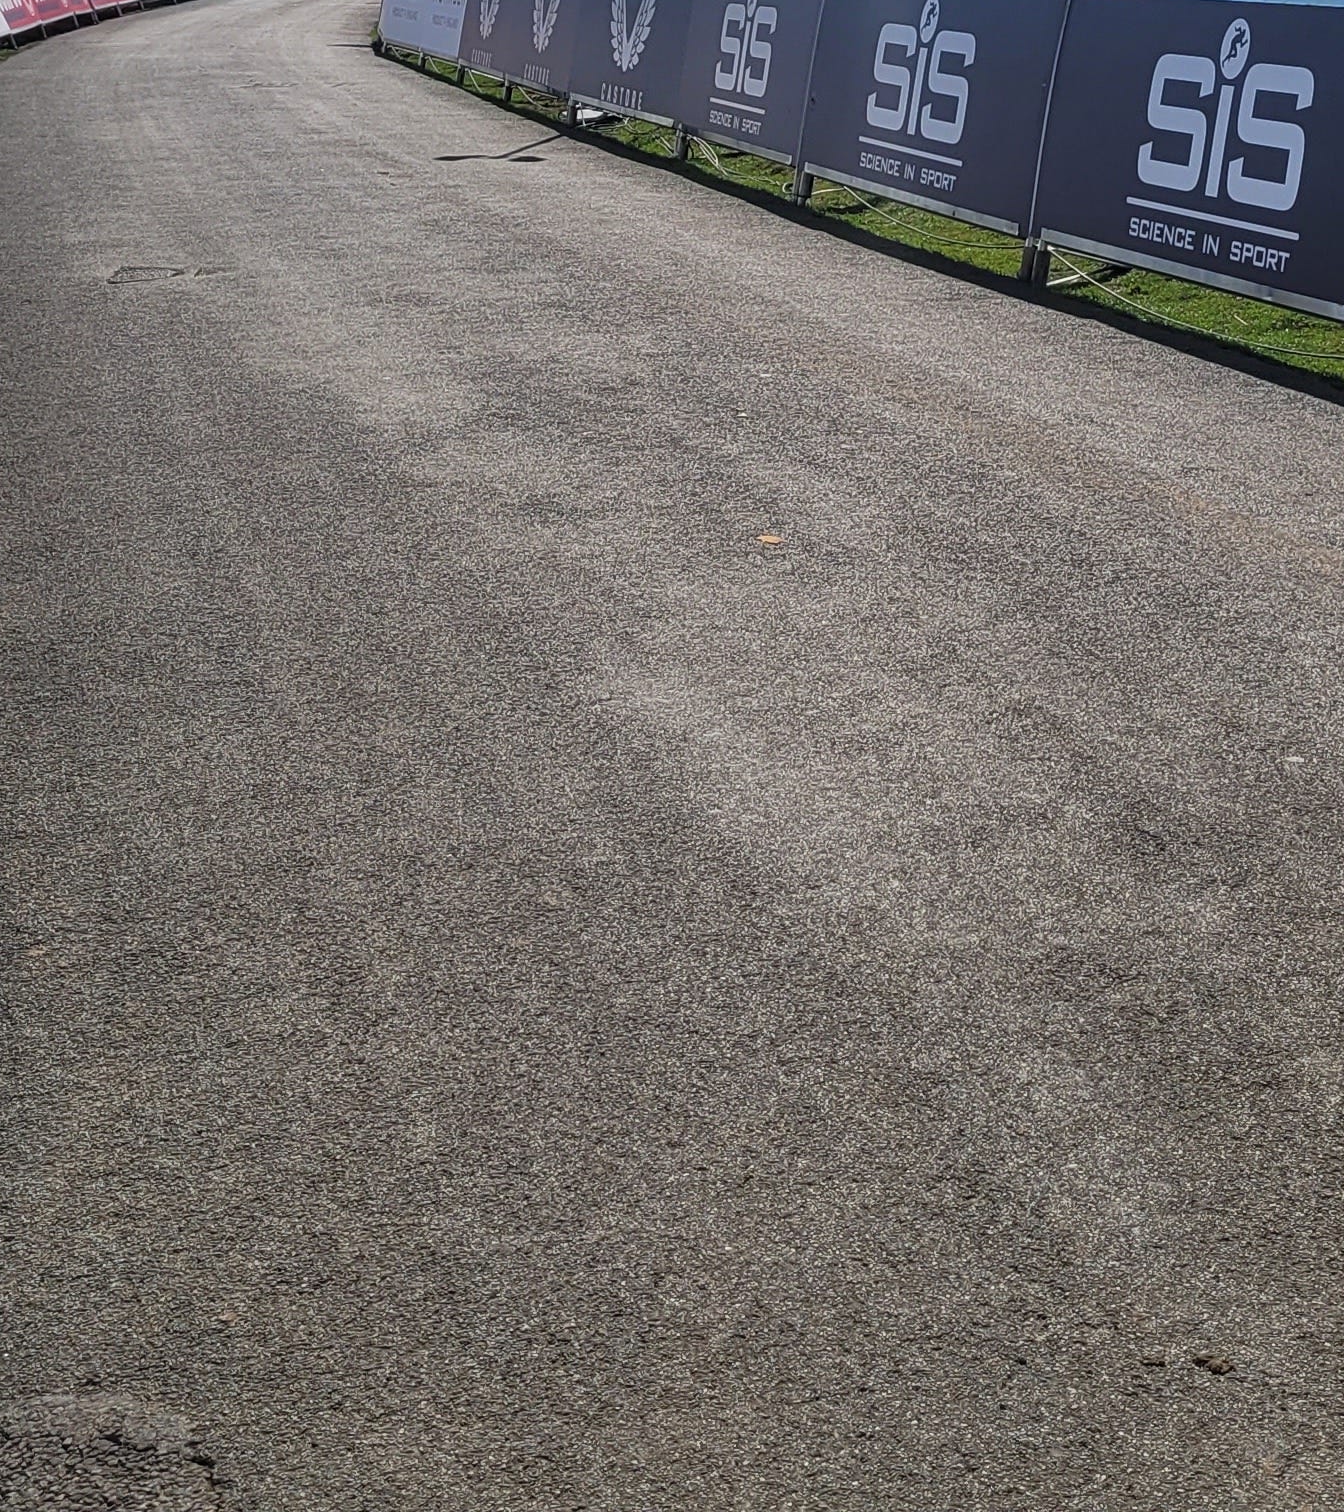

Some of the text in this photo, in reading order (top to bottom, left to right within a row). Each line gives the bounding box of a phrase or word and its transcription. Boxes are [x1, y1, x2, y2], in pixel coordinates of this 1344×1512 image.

[601, 82, 644, 111] CASTORE
[709, 109, 762, 136] SCIENCE IN SPORT
[859, 151, 957, 192] SCIENCE IN SPORT
[1128, 216, 1291, 273] SCIENCE IN SPORT
